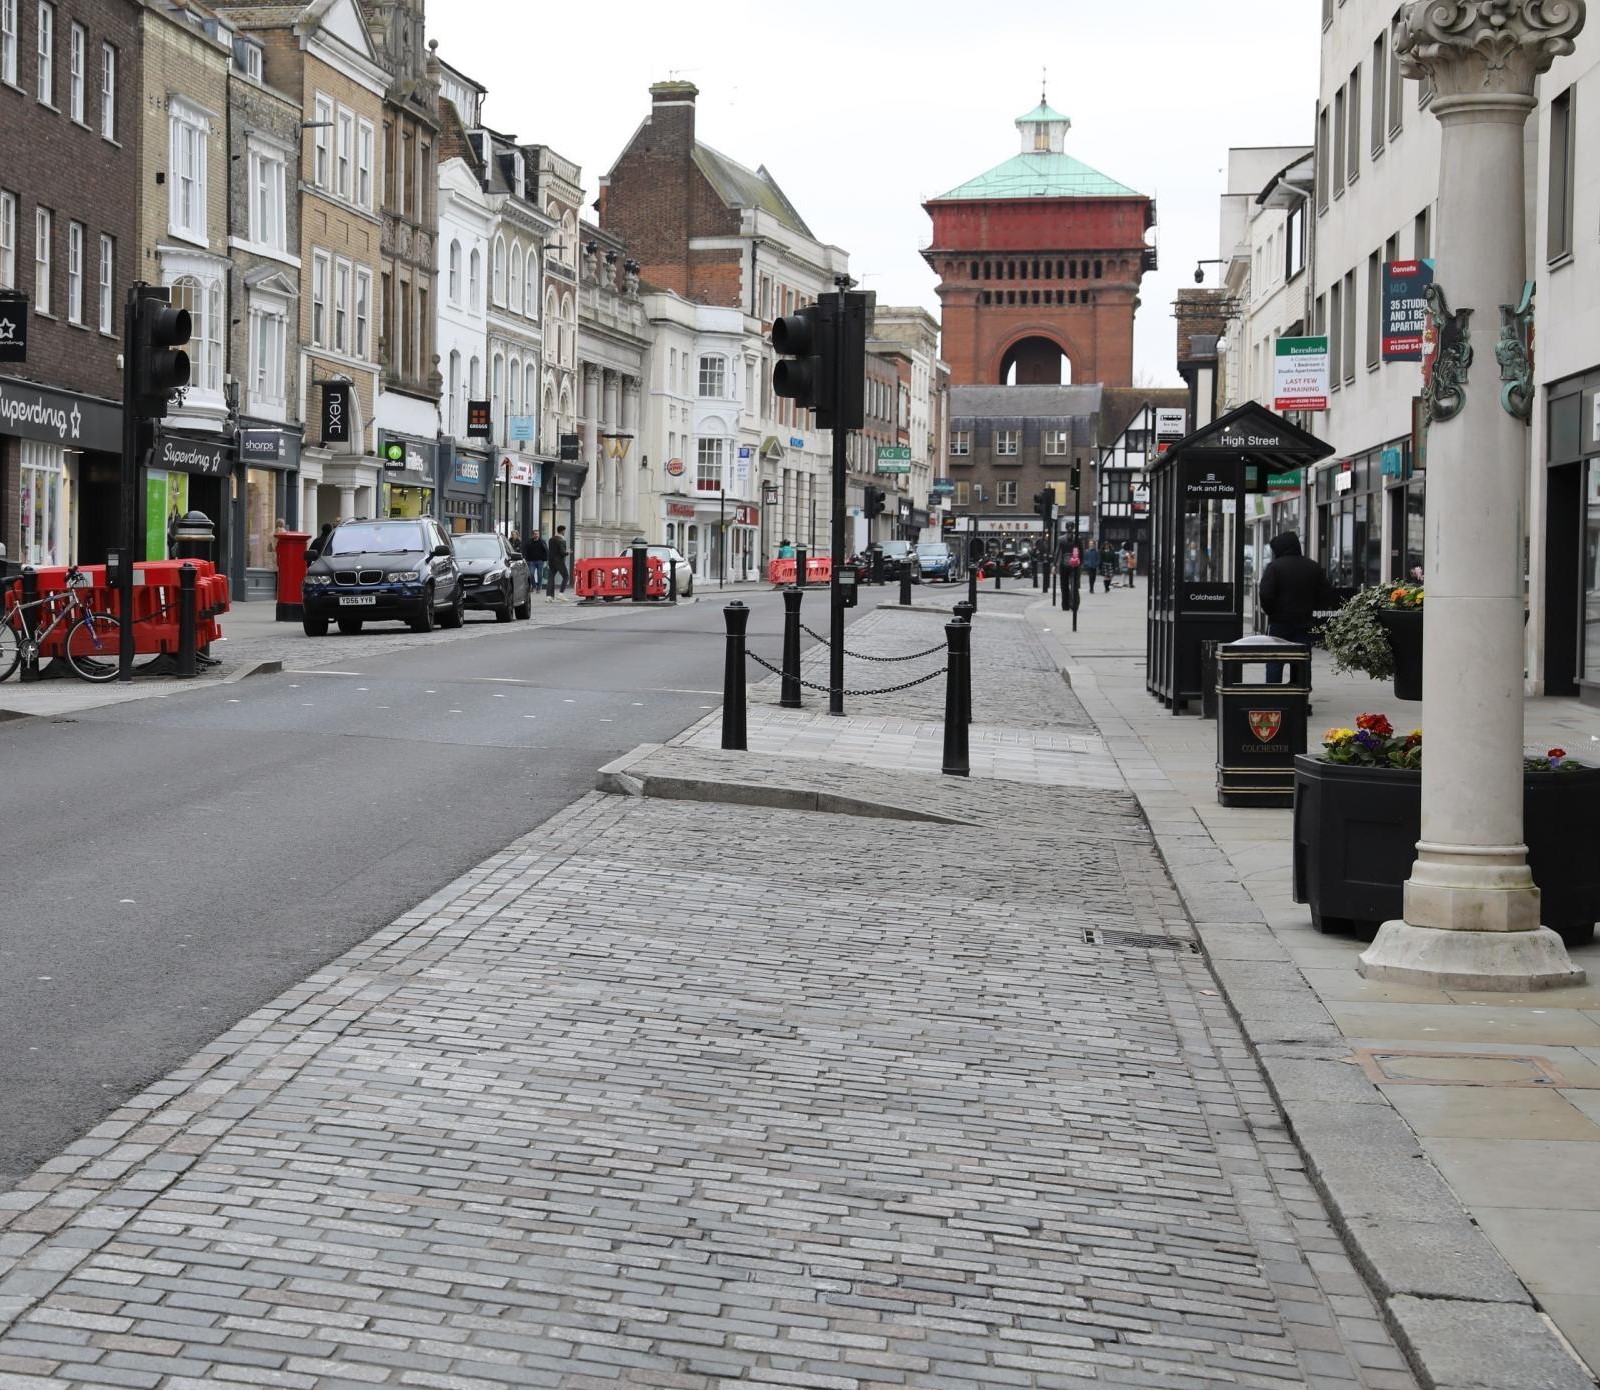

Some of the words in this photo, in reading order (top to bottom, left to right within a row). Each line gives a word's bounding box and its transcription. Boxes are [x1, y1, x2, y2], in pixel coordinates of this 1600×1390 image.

[1390, 301, 1400, 310] 35
[1401, 299, 1428, 309] STUDIO
[1390, 311, 1406, 321] AND
[1408, 311, 1412, 319] 1
[1413, 310, 1425, 319] BE
[1390, 321, 1425, 332] APARTME
[0, 386, 67, 438] uperdrug
[329, 393, 342, 434] next
[245, 440, 274, 450] sharps
[1221, 436, 1244, 447] High
[1248, 436, 1279, 446] Street
[163, 442, 210, 472] Superdrug
[461, 463, 479, 479] GREGGS
[1190, 593, 1226, 601] Colchester
[1242, 744, 1288, 752] COLCHESTER
